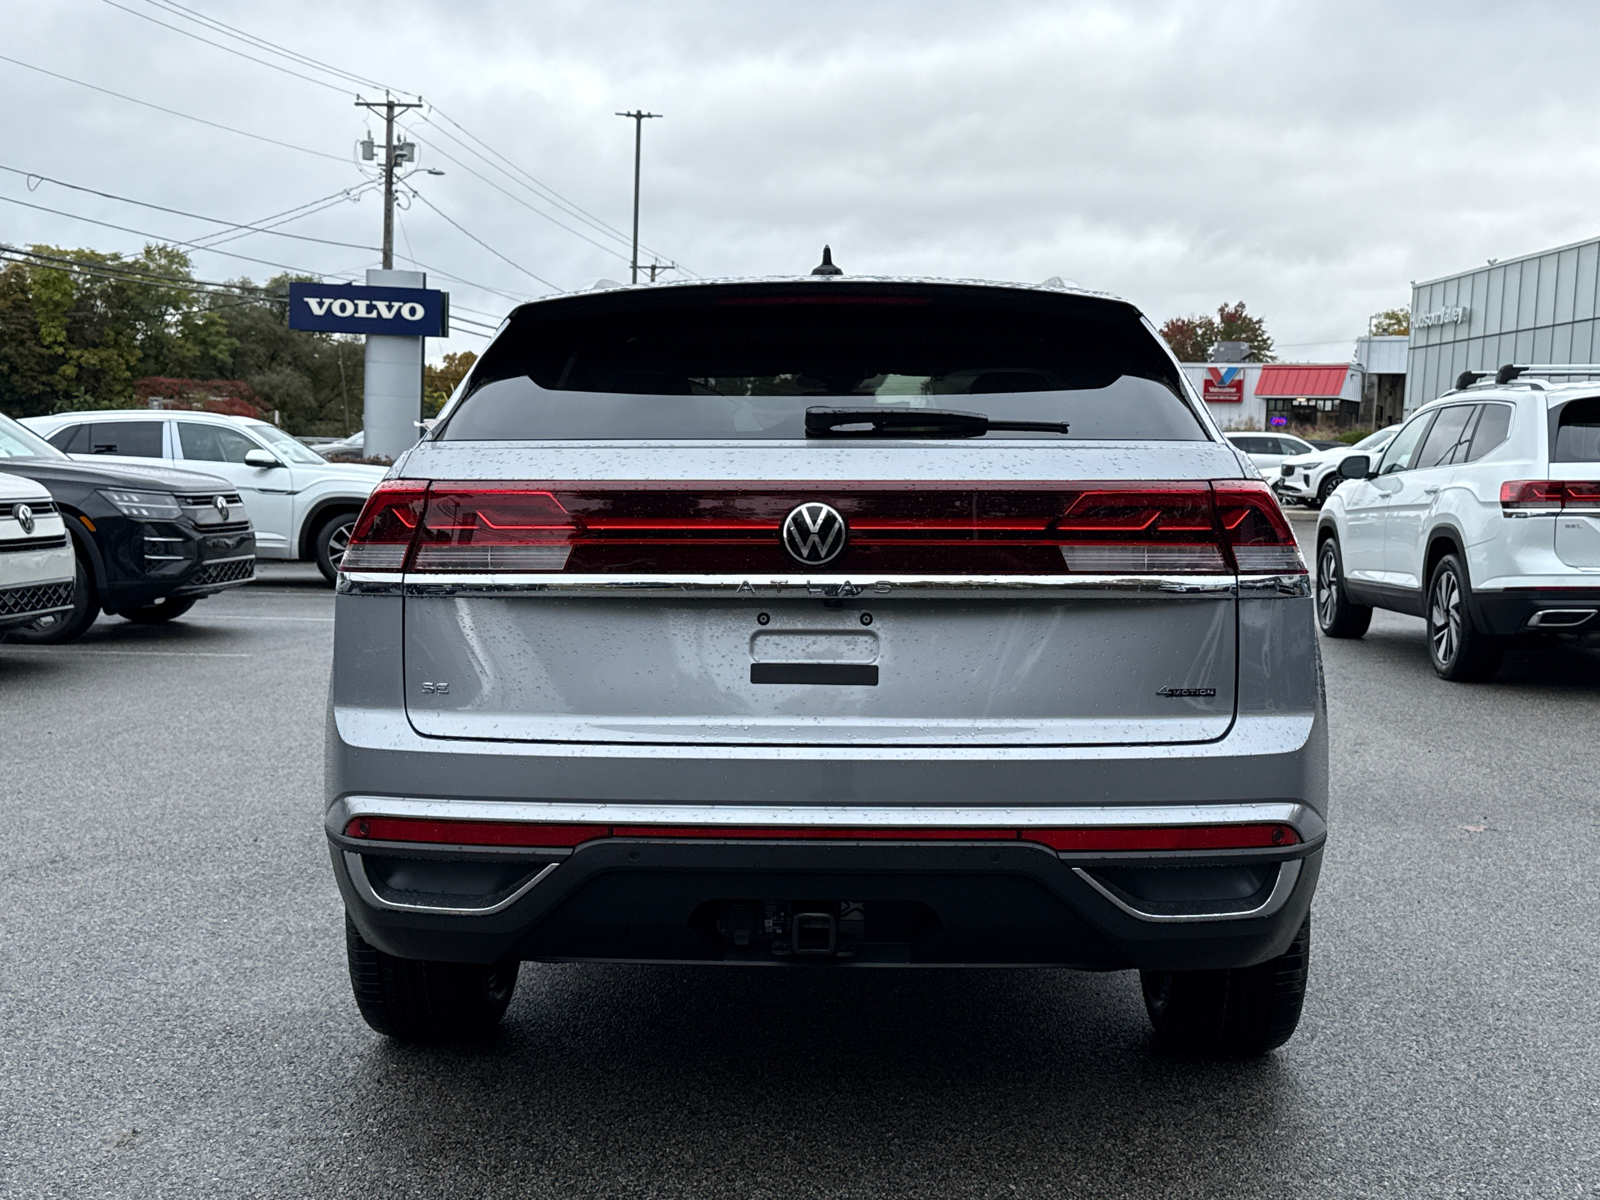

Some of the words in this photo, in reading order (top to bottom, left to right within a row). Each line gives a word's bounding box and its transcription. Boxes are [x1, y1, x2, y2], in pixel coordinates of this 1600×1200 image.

[303, 297, 425, 321] VOLVO
[783, 502, 846, 565] VW
[736, 579, 892, 594] ATLAS
[421, 681, 449, 694] SE
[1156, 685, 1216, 697] 4MOTION
